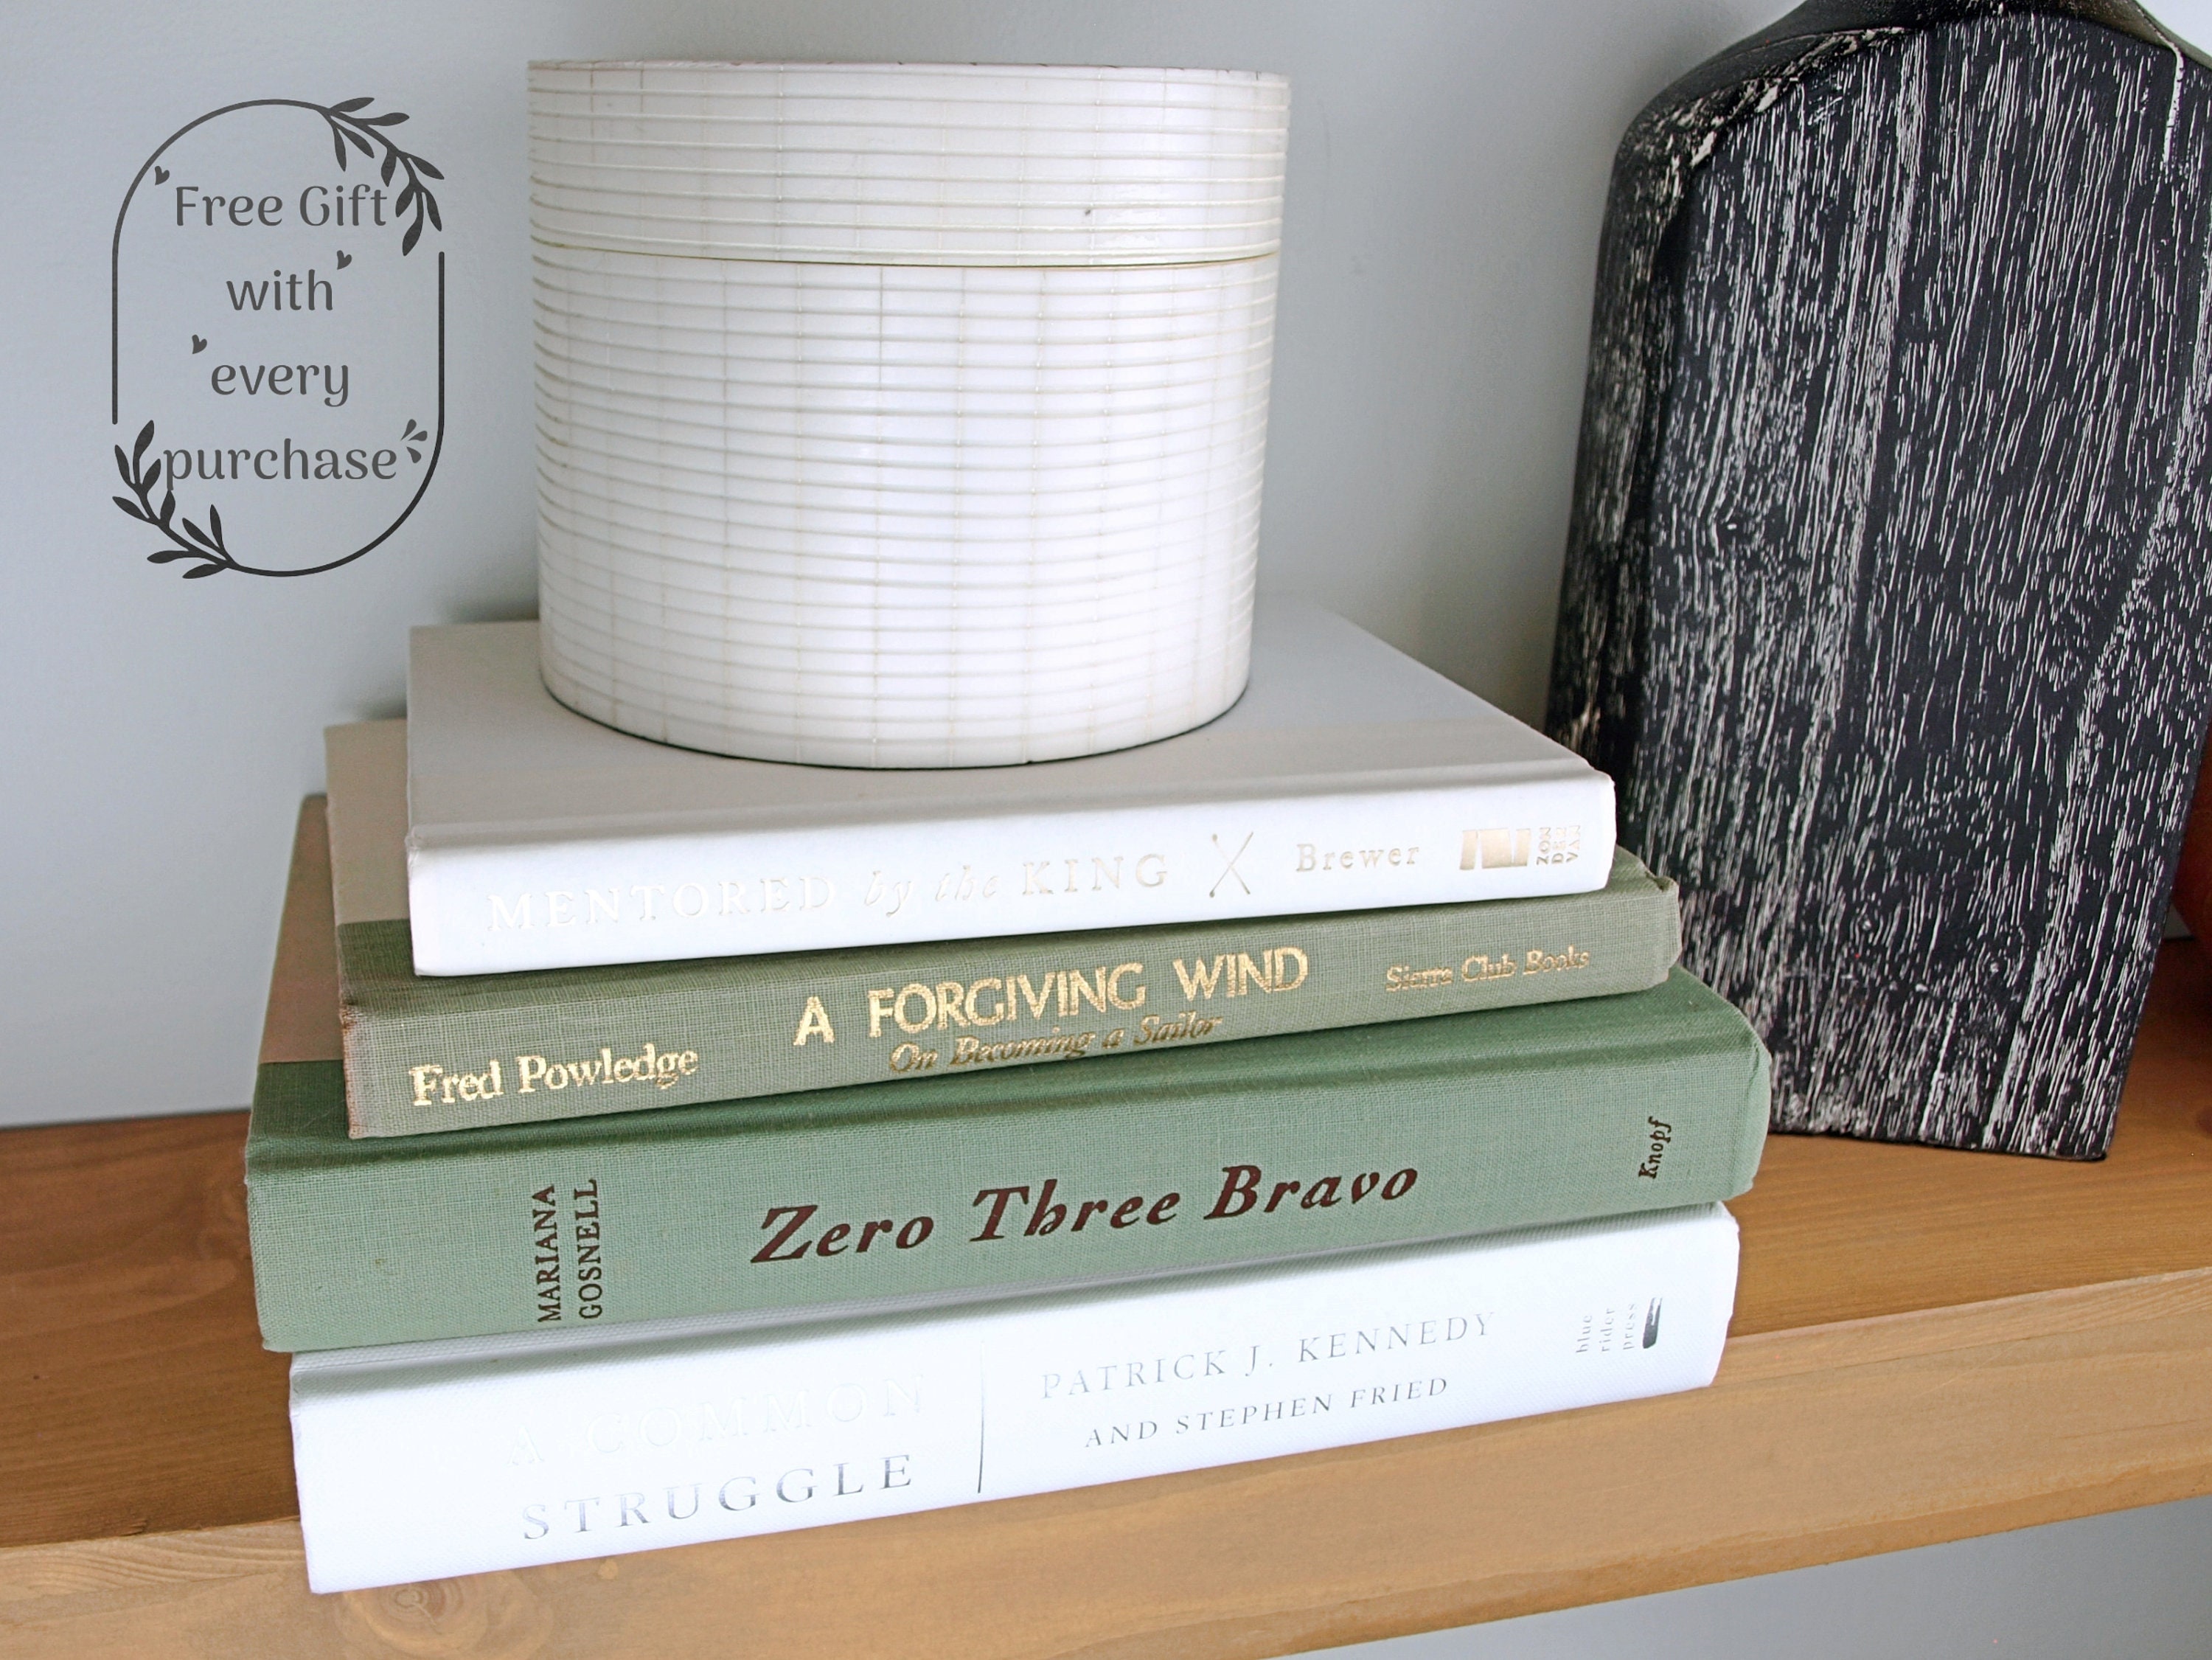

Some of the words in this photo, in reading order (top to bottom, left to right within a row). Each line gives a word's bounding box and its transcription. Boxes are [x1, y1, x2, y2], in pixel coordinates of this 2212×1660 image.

[487, 875, 836, 932] MENTORED
[864, 869, 914, 917] by
[935, 864, 999, 903] the
[1022, 853, 1168, 896] KING
[1295, 843, 1419, 873] Brewer
[793, 996, 835, 1046] A
[867, 962, 1147, 1038] FORGIVING
[1172, 946, 1310, 1002] WIND
[1385, 963, 1454, 993] Sierra
[1461, 953, 1517, 983] Club
[1523, 945, 1590, 976] Books
[409, 1059, 504, 1106] Fred
[515, 1043, 699, 1093] Powledge
[888, 1041, 938, 1074] On
[950, 1027, 1096, 1066] Becoming
[1102, 1028, 1125, 1049] a
[1133, 1010, 1224, 1046] Sailor
[1638, 1116, 1672, 1179] Knopf
[573, 1178, 603, 1320] GOSNELL
[750, 1204, 934, 1264] Zero
[970, 1178, 1180, 1242] Three
[1203, 1164, 1418, 1221] Bravo
[532, 1184, 562, 1323] MARIANA
[1042, 1349, 1227, 1399] PATRICK
[1245, 1344, 1274, 1378] J.
[1298, 1311, 1496, 1364] KENNEDY
[1576, 1313, 1593, 1354] blue
[1599, 1307, 1615, 1353] rider
[1623, 1302, 1638, 1351] press
[586, 1374, 925, 1454] COMMON
[1084, 1419, 1158, 1448] AND
[1175, 1393, 1332, 1435] STEPHEN
[1349, 1376, 1448, 1409] FRIED
[522, 1454, 913, 1541] STRUGGLE
